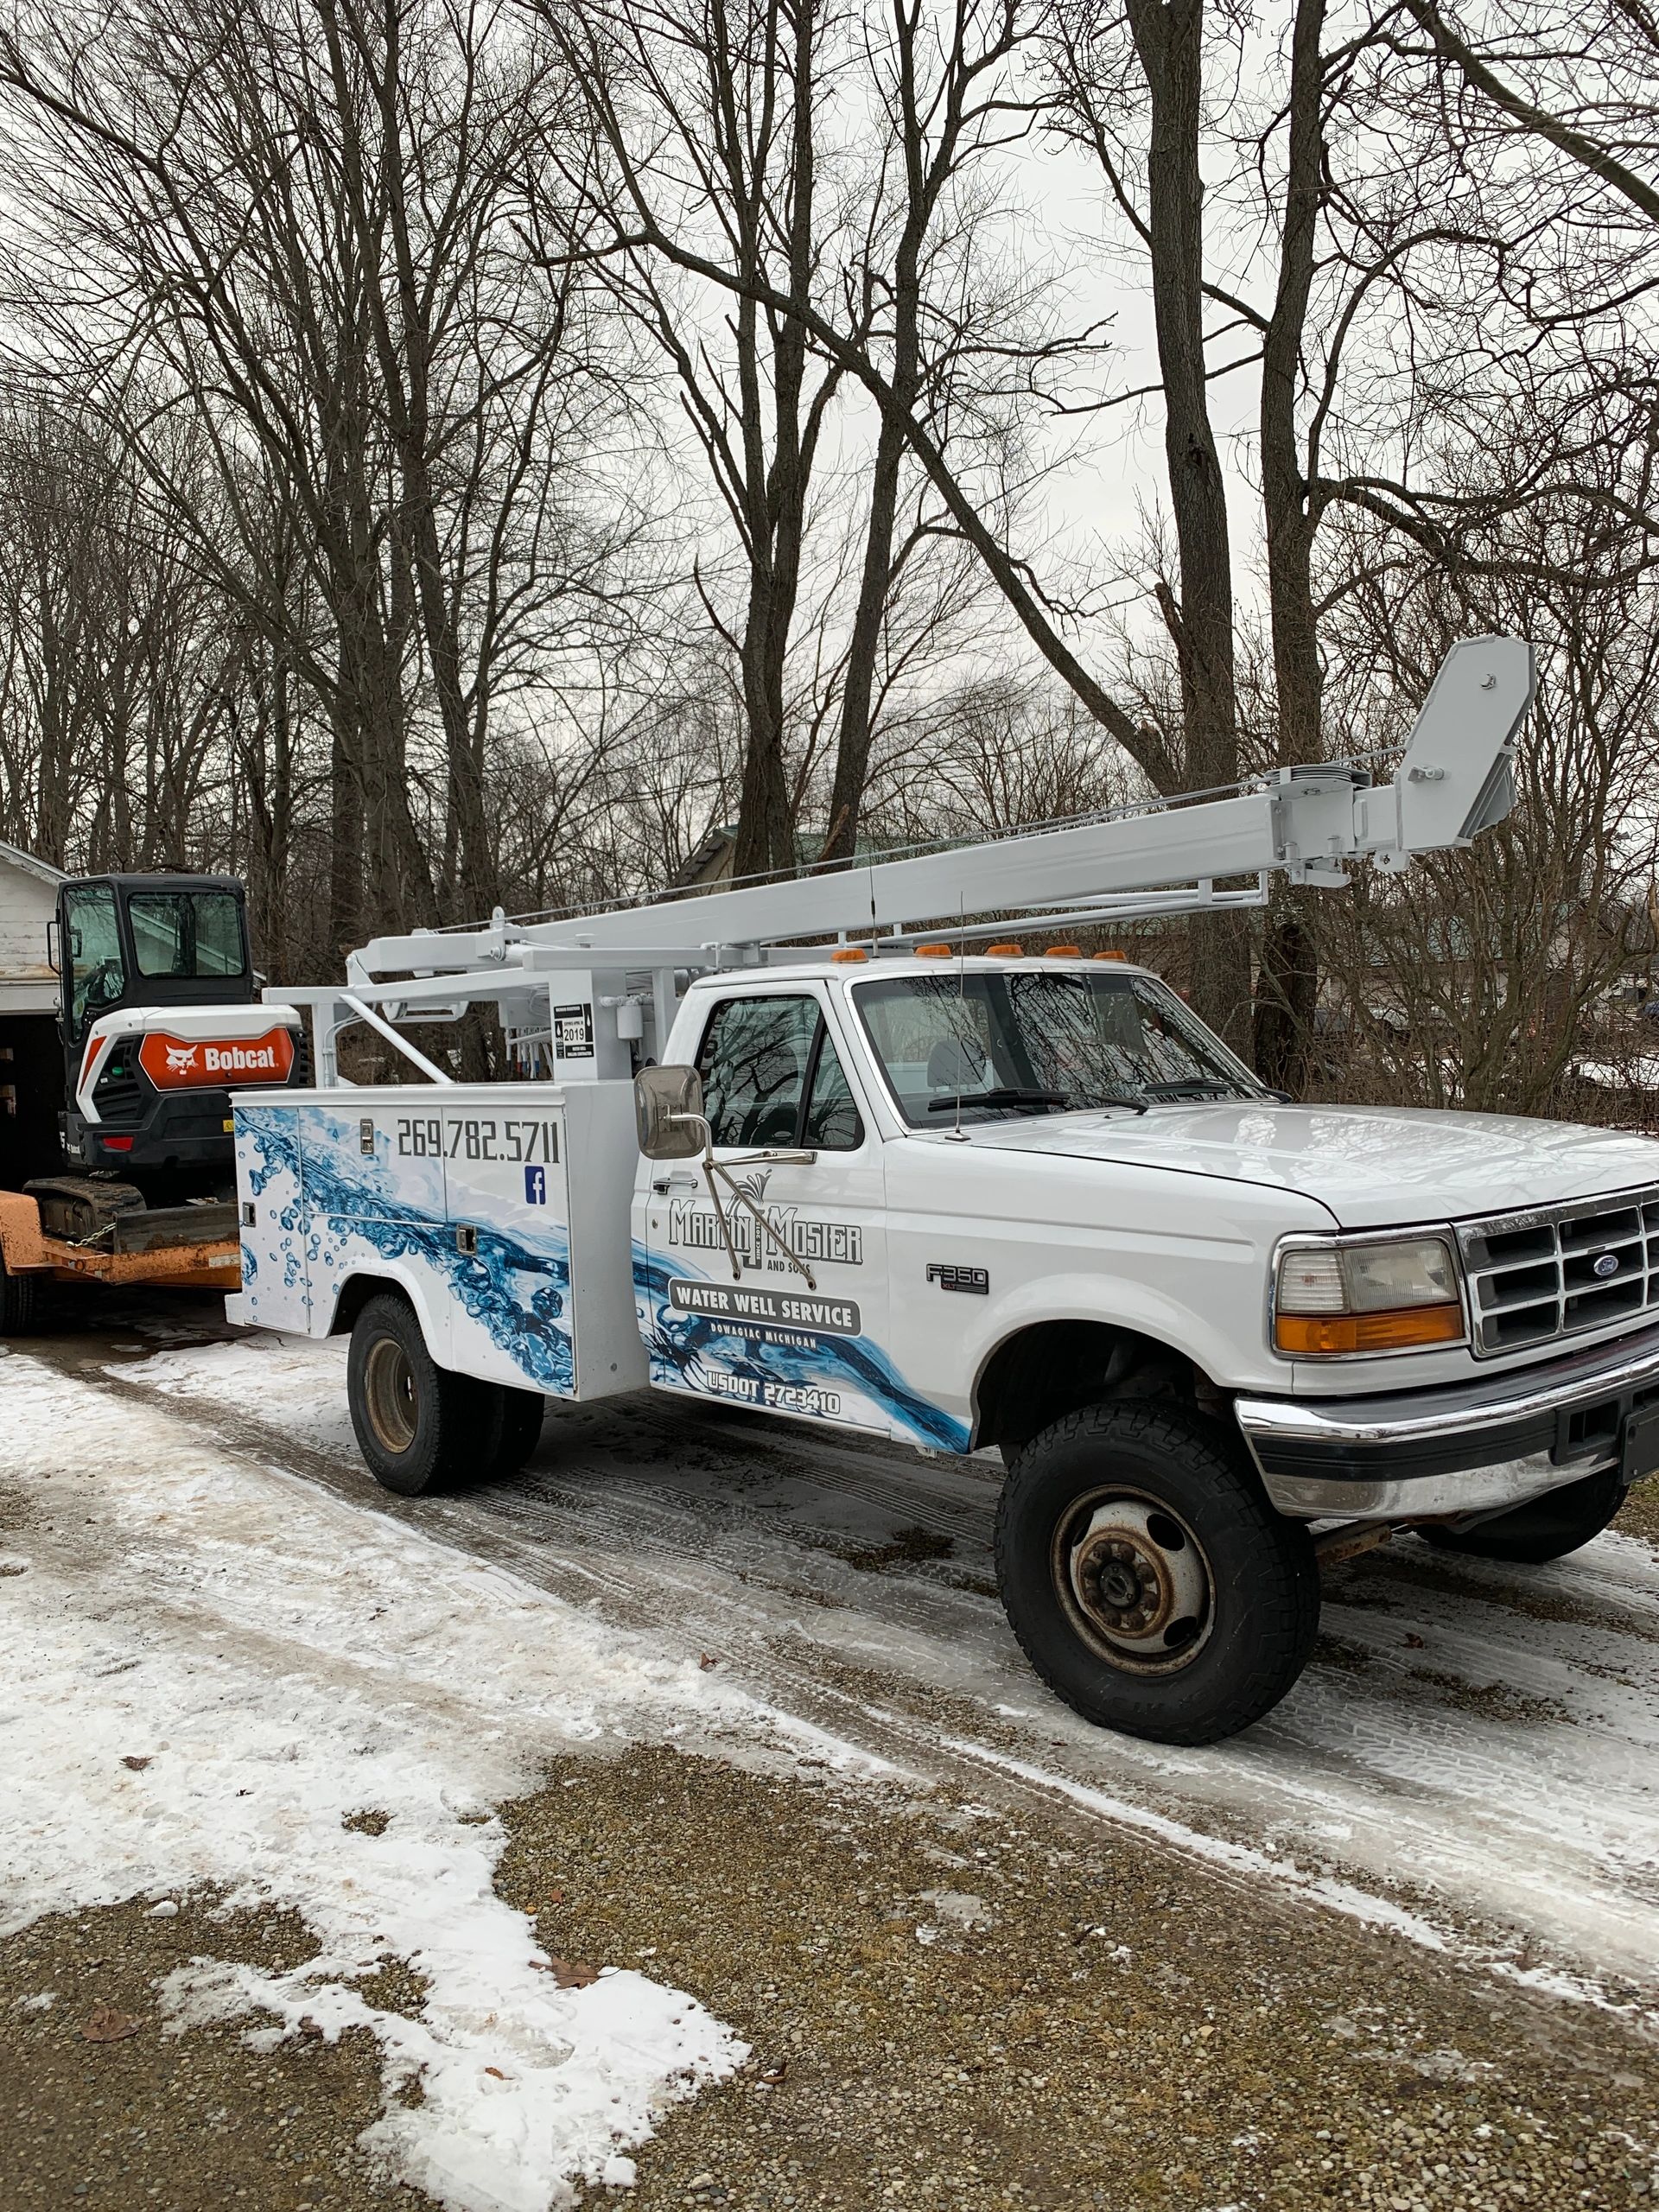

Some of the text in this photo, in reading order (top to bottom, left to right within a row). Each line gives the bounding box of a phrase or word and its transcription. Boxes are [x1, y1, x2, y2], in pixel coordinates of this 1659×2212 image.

[563, 1027, 584, 1041] 2019
[204, 1046, 276, 1071] Bobcat
[397, 1119, 560, 1164] 269.782.5711
[766, 1205, 863, 1265] MOSIER
[767, 1259, 811, 1274] AND SOS
[676, 1286, 853, 1328] WATER WELL SERVICE
[710, 1322, 817, 1349] DOWAGIAC MICHIGAN
[707, 1370, 841, 1414] USDOT 2723410
